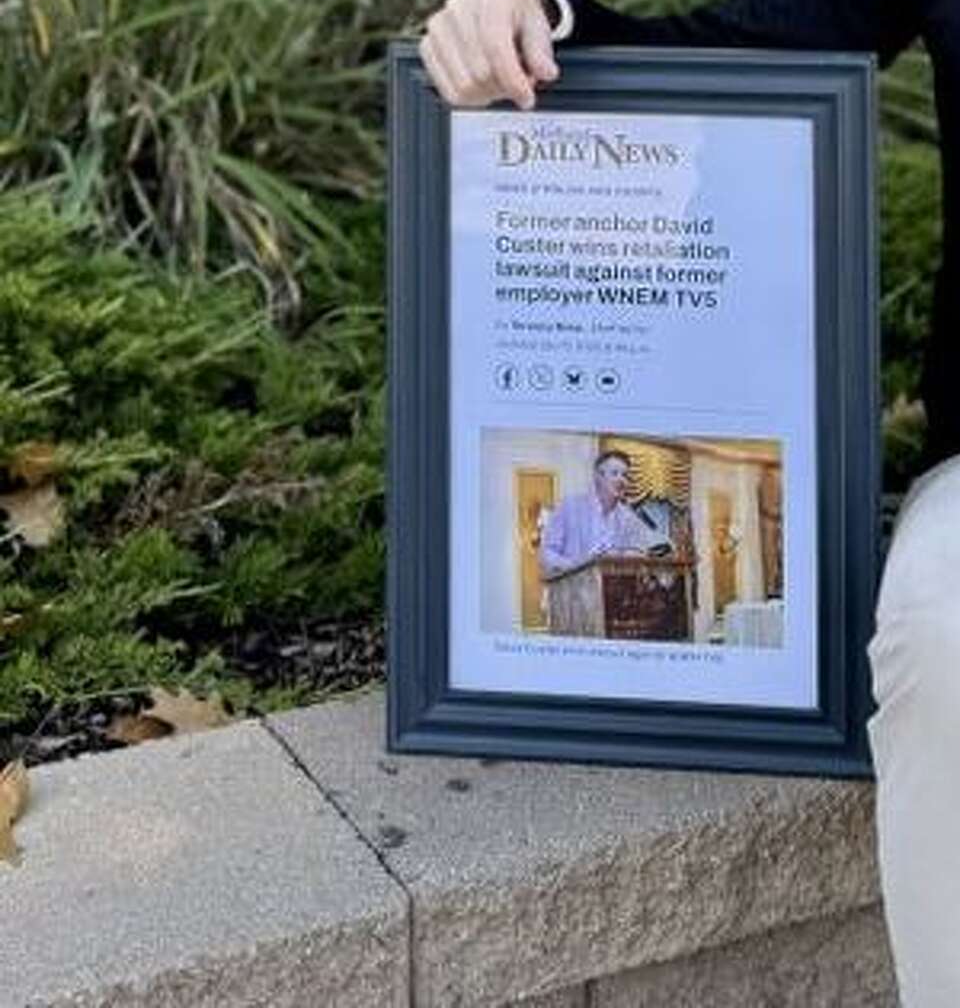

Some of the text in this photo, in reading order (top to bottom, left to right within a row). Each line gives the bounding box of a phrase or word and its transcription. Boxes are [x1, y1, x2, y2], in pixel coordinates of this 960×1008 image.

[496, 211, 714, 235] Former anchor David
[496, 236, 565, 254] Custer
[568, 239, 619, 256] wins
[496, 261, 727, 284] lawsuit against former
[496, 285, 595, 307] employer
[596, 287, 668, 306] WNEM
